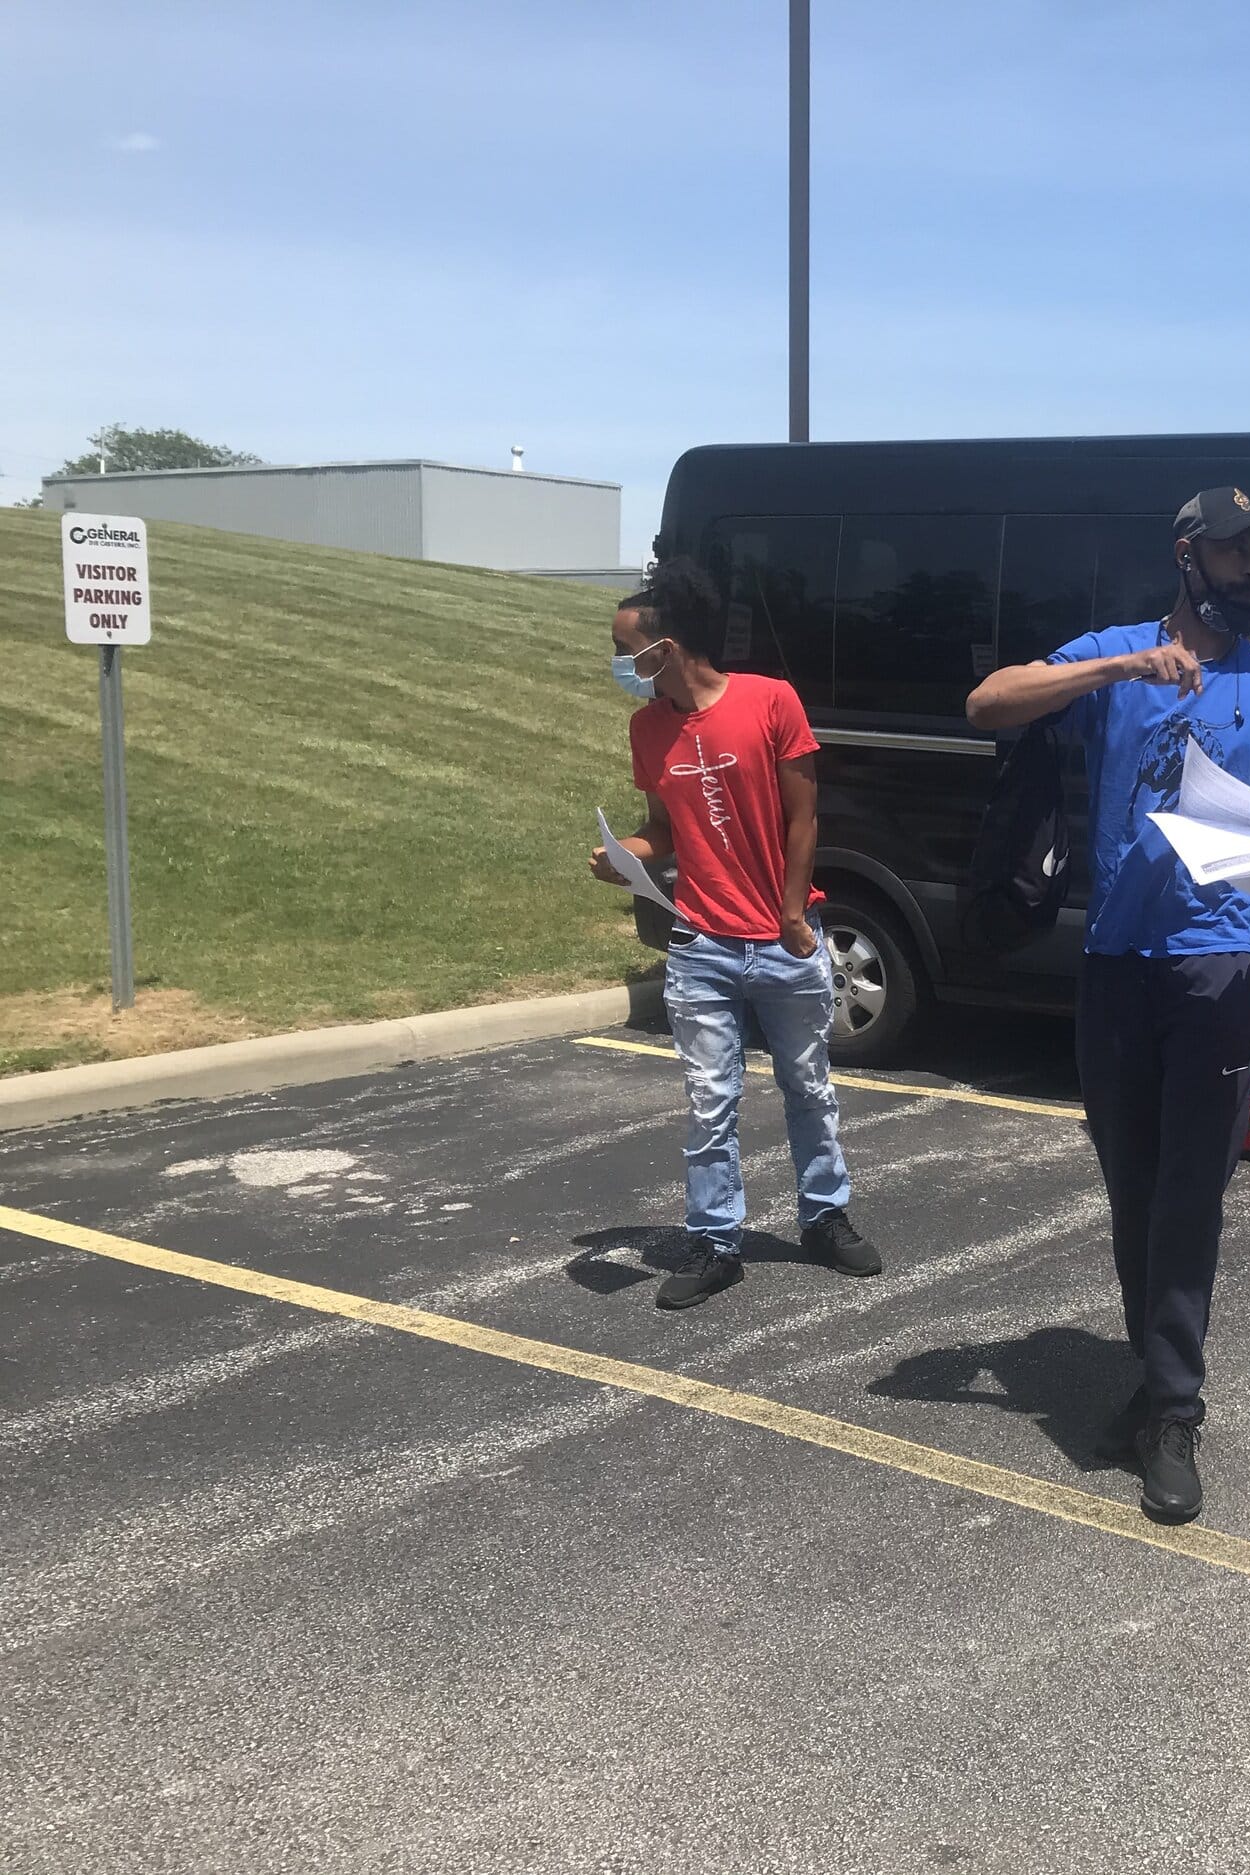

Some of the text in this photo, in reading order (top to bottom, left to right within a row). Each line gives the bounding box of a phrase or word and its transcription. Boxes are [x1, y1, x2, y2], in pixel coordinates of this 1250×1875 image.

[87, 528, 140, 542] GENERAL
[76, 563, 137, 581] VISITOR
[73, 588, 142, 606] PARKING
[89, 613, 128, 629] ONLY
